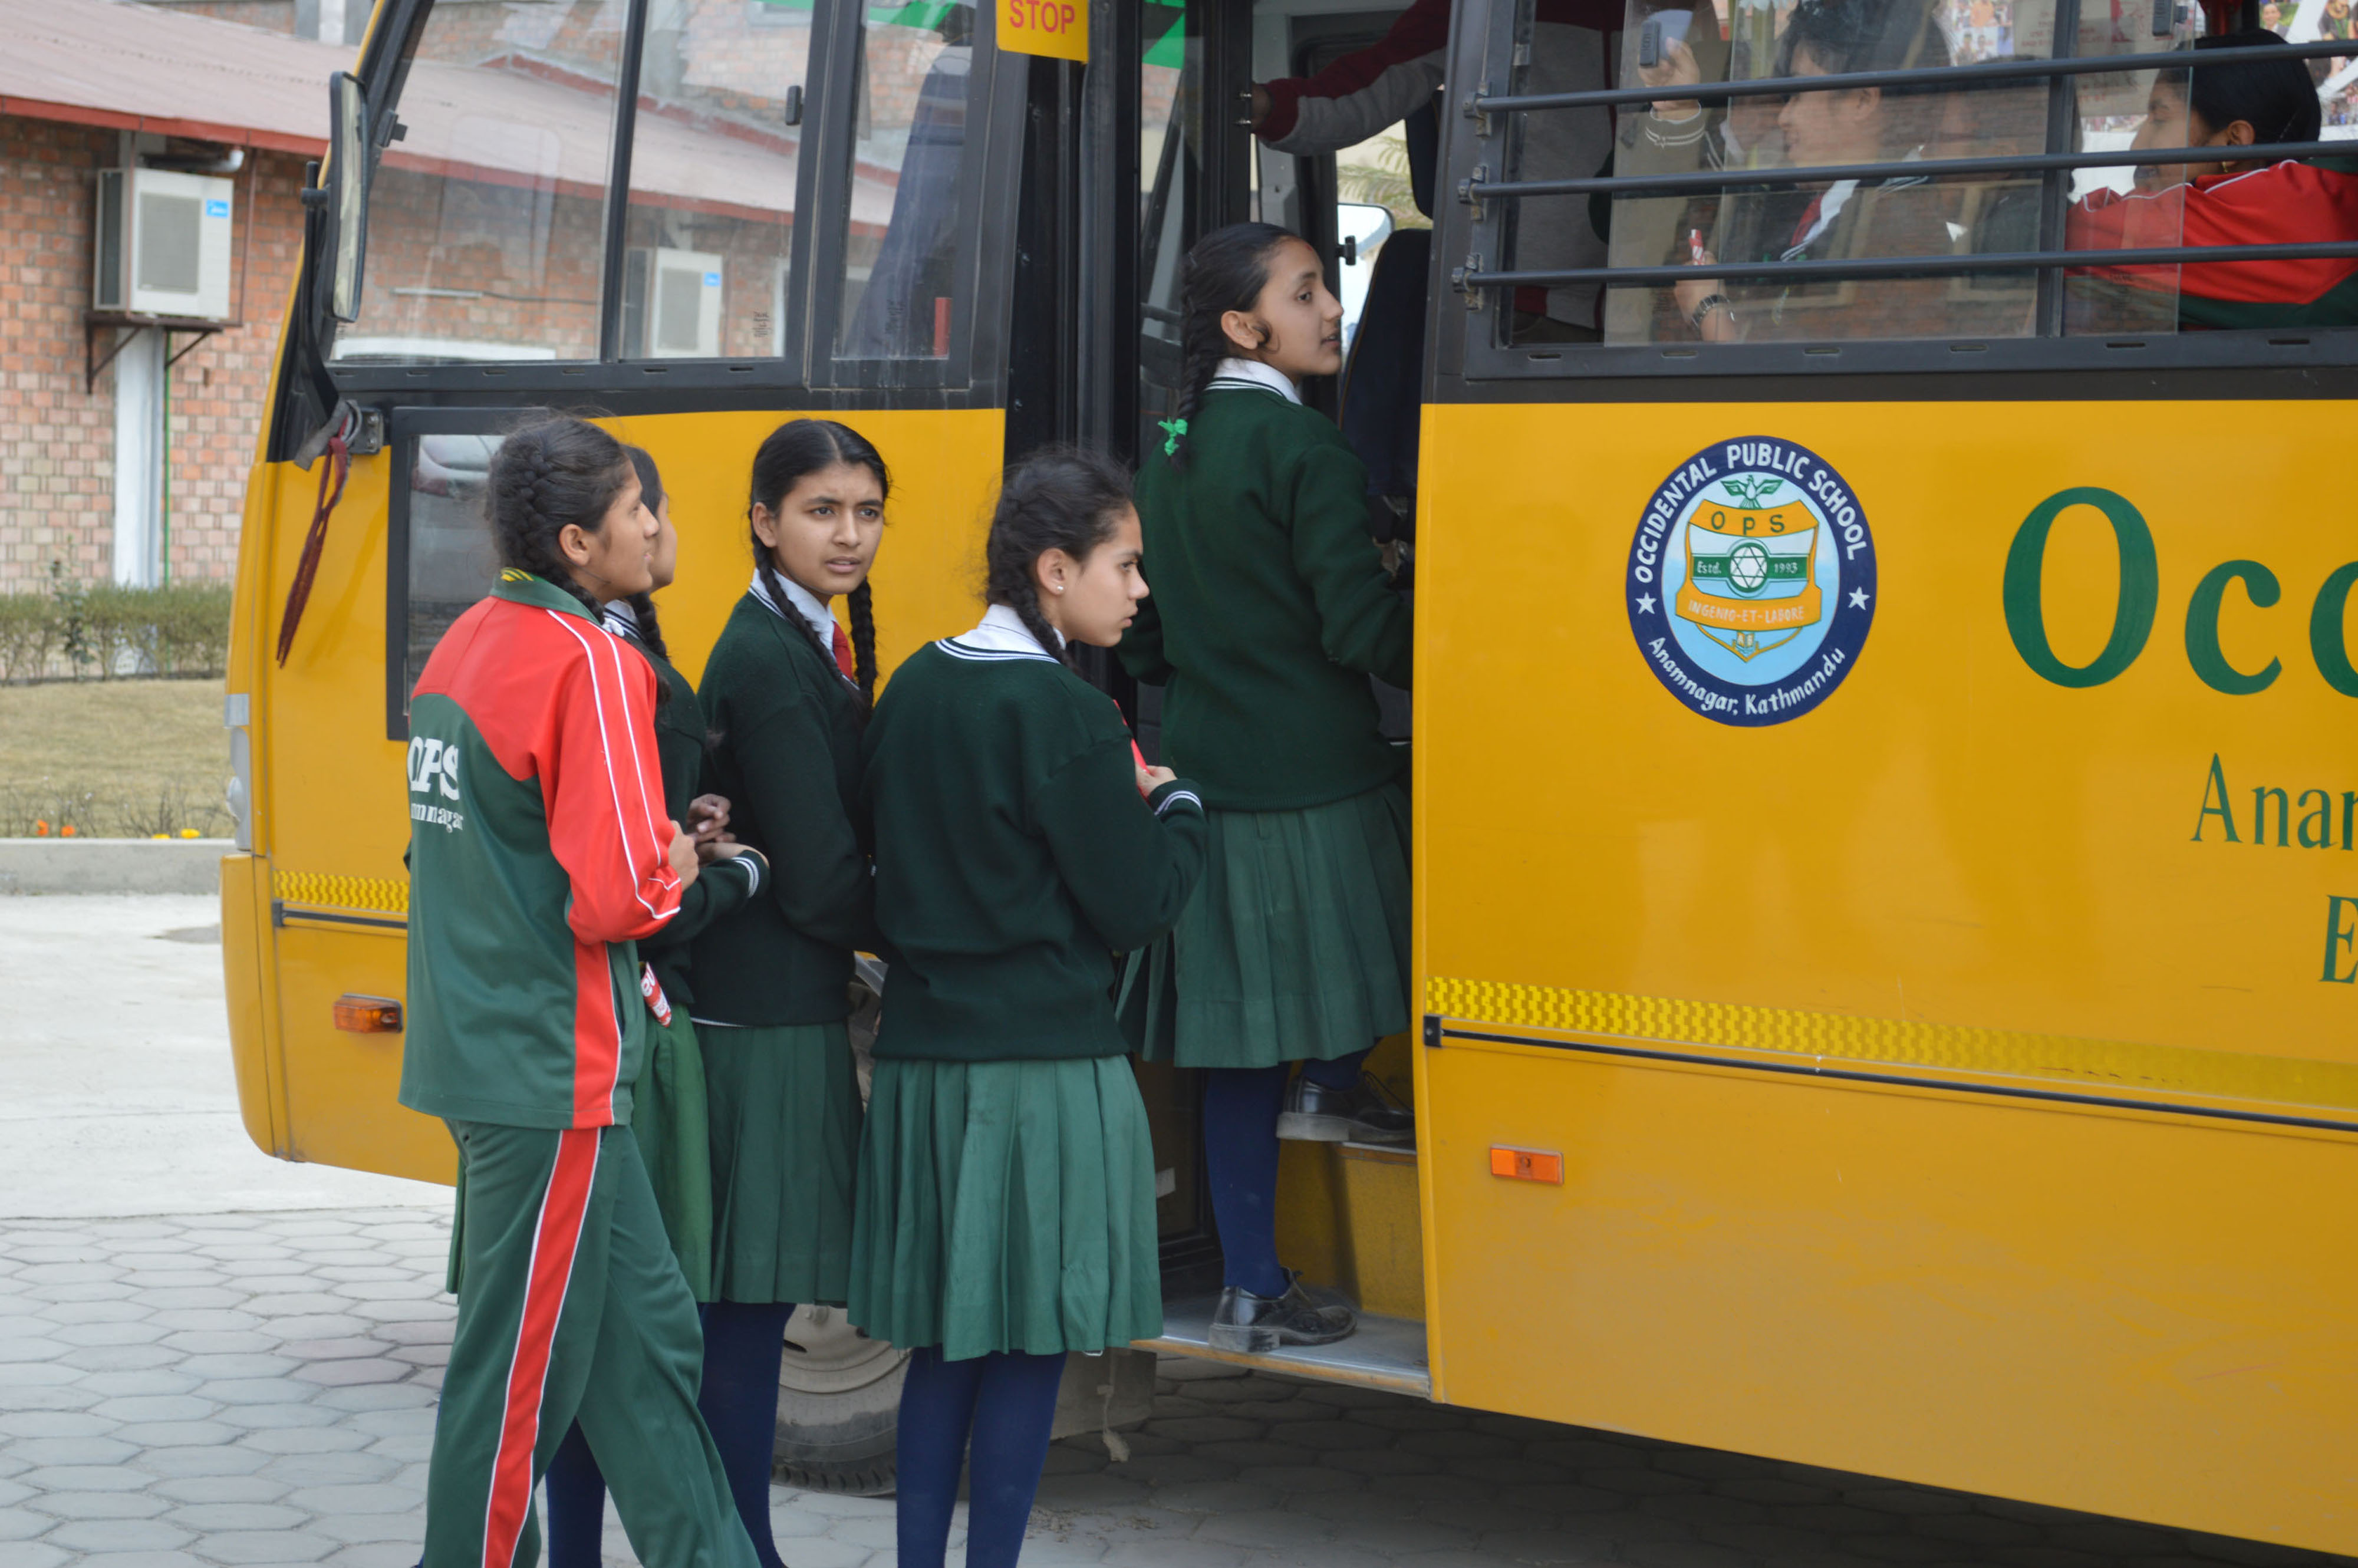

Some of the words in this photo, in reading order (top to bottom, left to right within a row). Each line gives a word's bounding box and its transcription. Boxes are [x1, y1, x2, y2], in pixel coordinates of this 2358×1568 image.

[1009, 0, 1075, 34] STOP
[1635, 457, 1717, 584] OCCIDENTAL
[1727, 443, 1810, 479] PUBLIC
[1808, 469, 1868, 561] SCHOOL
[1697, 561, 1722, 574] Estd.
[1648, 637, 1738, 716] Anamnagar,
[1745, 648, 1846, 715] Kathmandu
[407, 736, 460, 801] OPS
